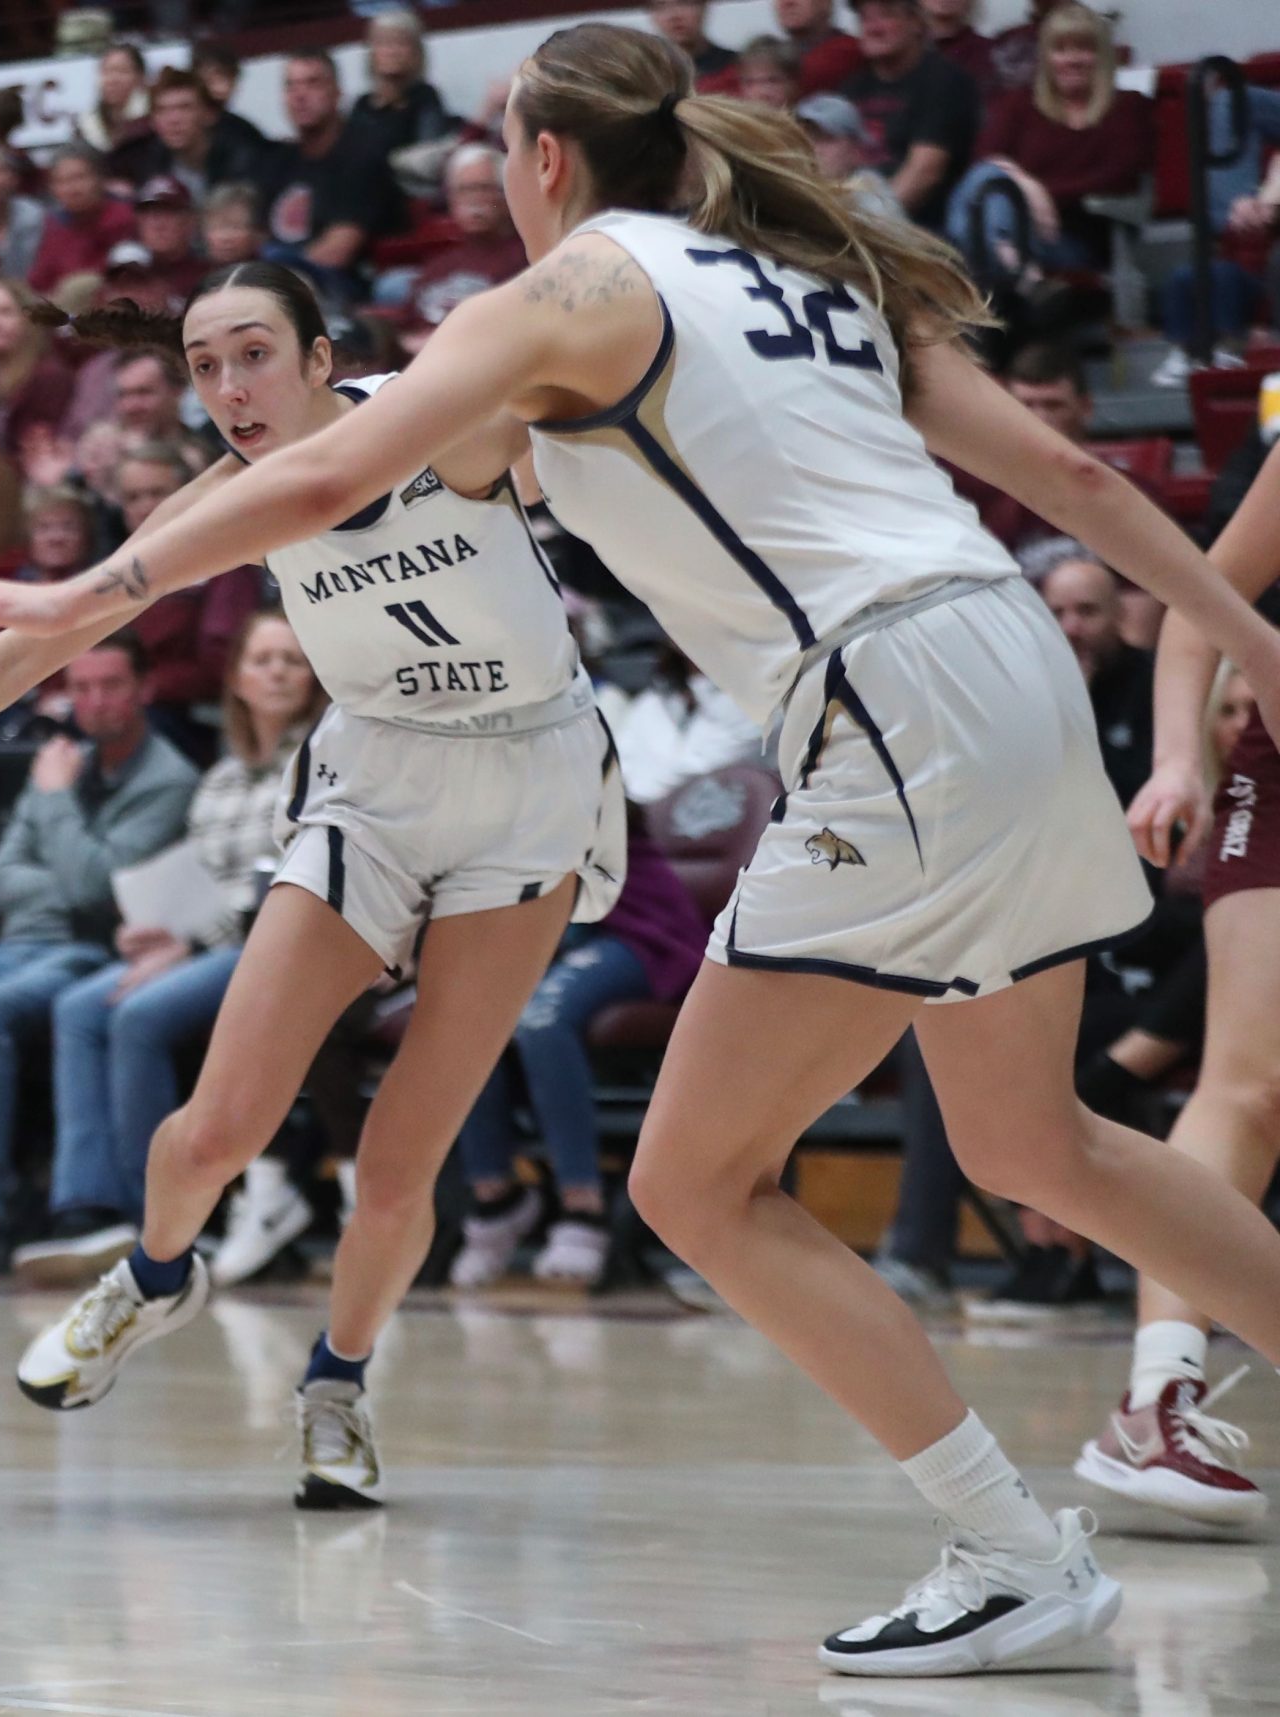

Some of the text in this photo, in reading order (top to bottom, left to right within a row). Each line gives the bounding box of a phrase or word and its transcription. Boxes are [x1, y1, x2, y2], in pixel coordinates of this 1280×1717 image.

[684, 248, 884, 374] 32
[414, 469, 439, 494] SKY
[300, 534, 479, 604] MONTANA
[383, 600, 462, 647] 11
[396, 660, 509, 696] STATE
